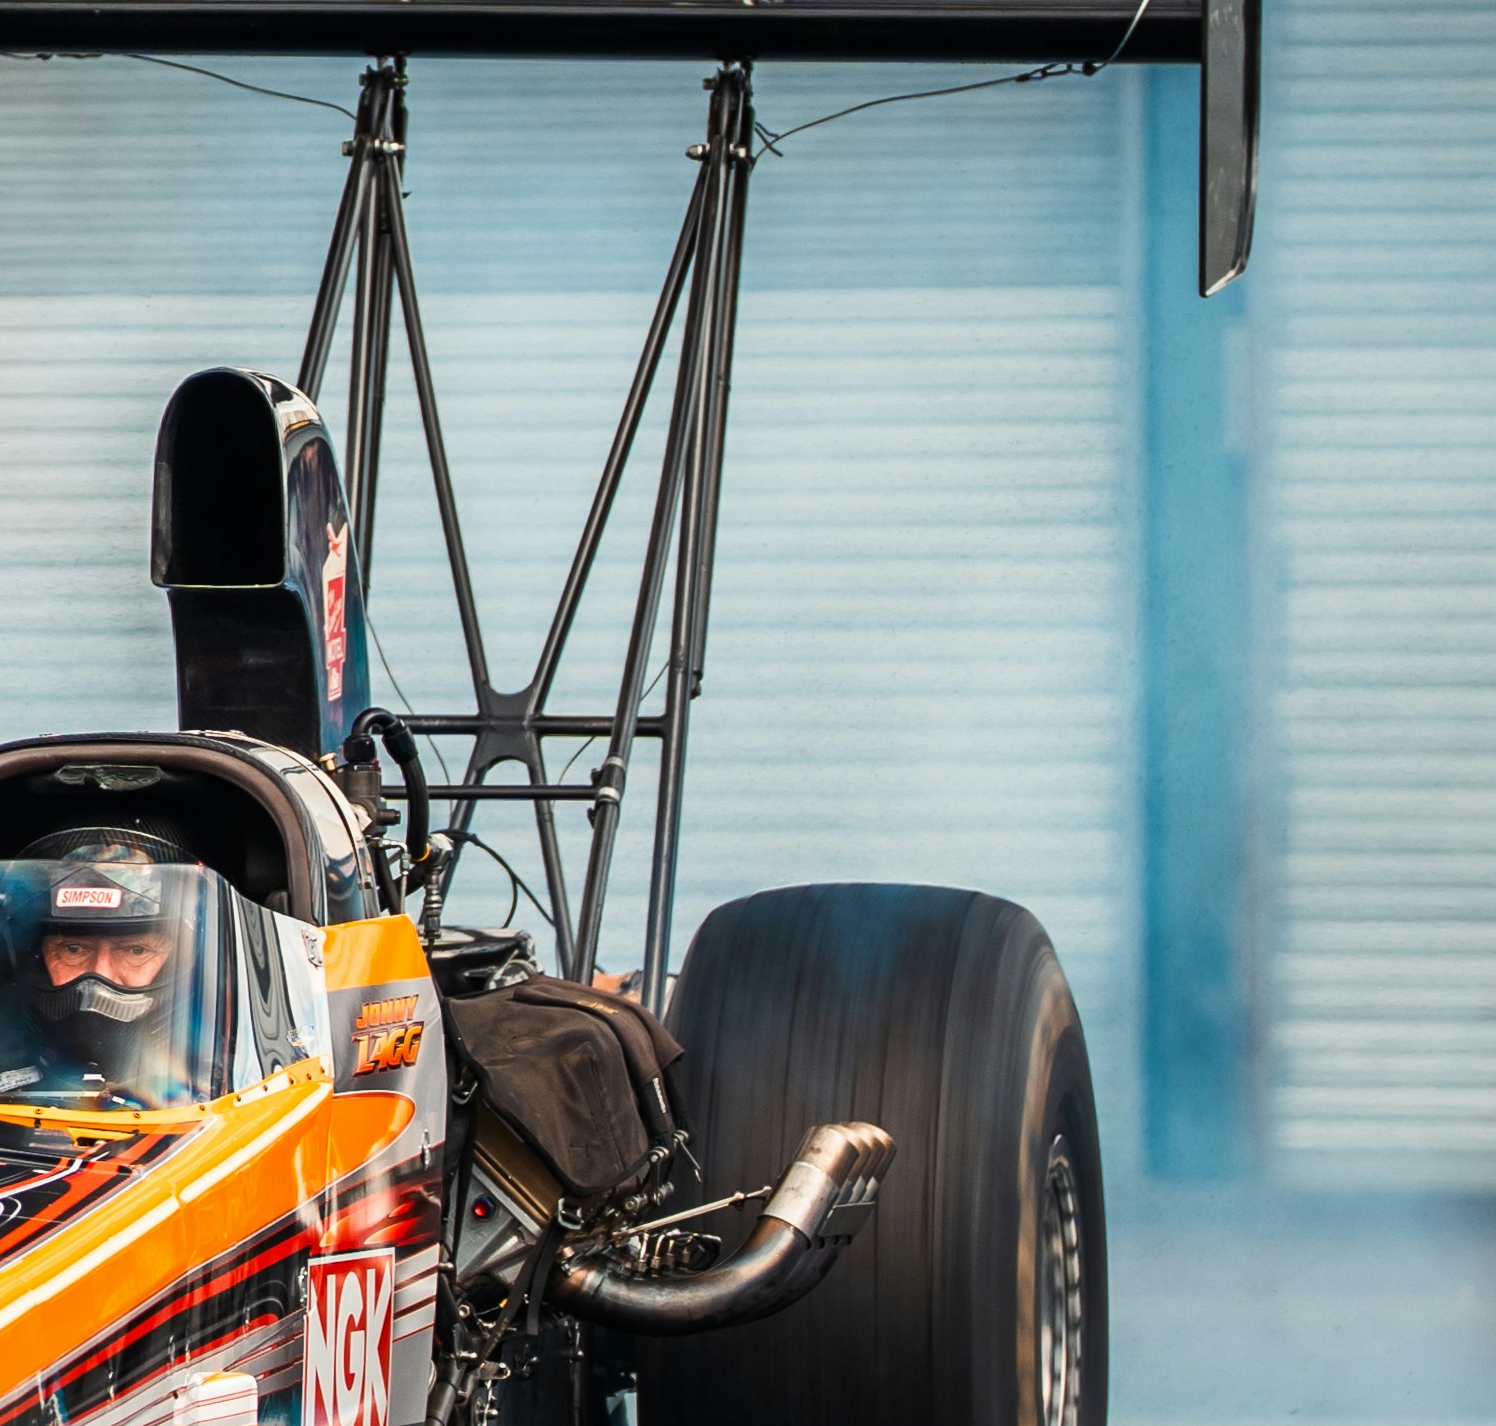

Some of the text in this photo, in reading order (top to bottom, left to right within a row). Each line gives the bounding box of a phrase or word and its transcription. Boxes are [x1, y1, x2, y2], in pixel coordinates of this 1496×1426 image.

[61, 890, 113, 904] SIMPSON
[356, 994, 419, 1030] JONNY
[352, 1021, 424, 1078] LAGG
